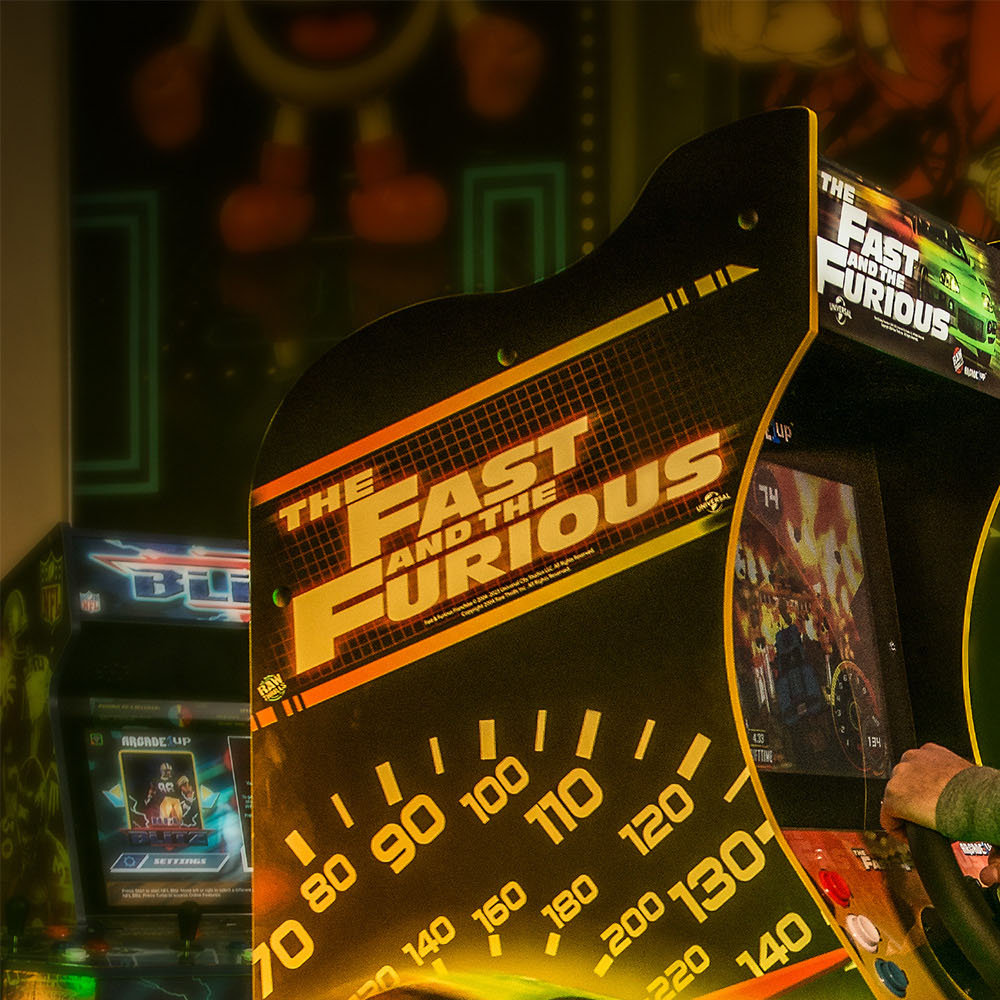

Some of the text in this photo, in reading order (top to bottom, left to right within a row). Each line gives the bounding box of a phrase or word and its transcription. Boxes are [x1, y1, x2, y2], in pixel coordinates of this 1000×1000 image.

[820, 171, 856, 205] THE
[837, 201, 920, 279] FAST
[847, 251, 906, 290] AND THE
[816, 235, 951, 342] FURIOUS
[279, 468, 374, 531] THE
[347, 415, 589, 568] FAST
[758, 483, 779, 511] 74
[292, 432, 724, 675] FURIOUS
[386, 480, 557, 576] AND THE
[459, 756, 530, 824] 100
[524, 768, 604, 845] 110
[617, 782, 695, 856] 120
[371, 794, 446, 875] 90
[300, 854, 357, 913] 80
[471, 880, 528, 934] 160
[541, 873, 600, 931] 180
[667, 830, 767, 924] 130
[401, 915, 457, 967] 140
[600, 890, 666, 958] 200
[735, 911, 813, 978] 140
